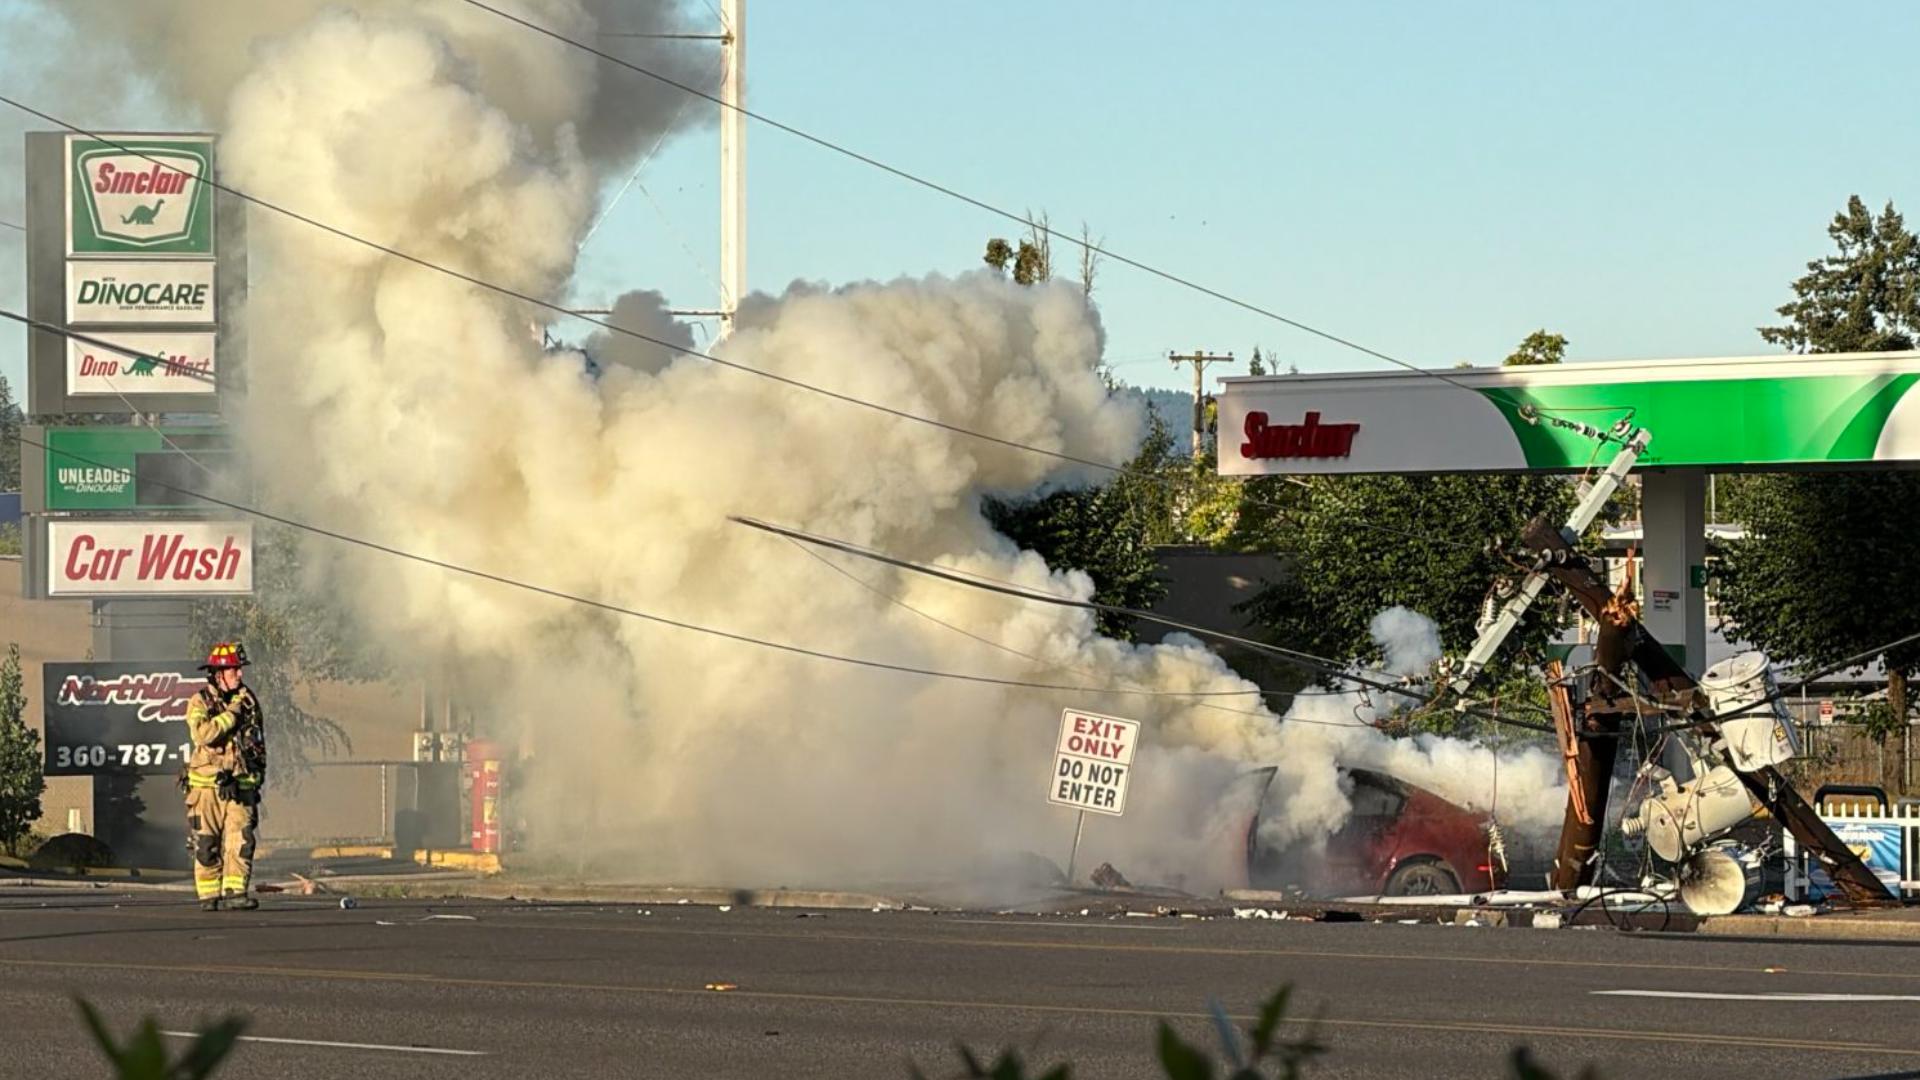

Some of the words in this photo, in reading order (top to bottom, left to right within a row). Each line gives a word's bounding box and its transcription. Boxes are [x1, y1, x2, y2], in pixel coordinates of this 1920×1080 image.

[95, 163, 192, 194] Sinclair
[77, 280, 209, 304] DINOCARE
[79, 355, 118, 376] Dino
[58, 468, 131, 484] UNLEADED
[76, 483, 125, 493] DINOCARE
[65, 534, 133, 581] Car
[137, 534, 241, 581] Wash
[1073, 717, 1126, 741] EXIT
[56, 743, 191, 767] 360-787-1
[1067, 735, 1125, 759] ONLY
[1058, 758, 1083, 779] DO
[1088, 763, 1124, 787] NOT
[1058, 780, 1116, 808] ENTER
